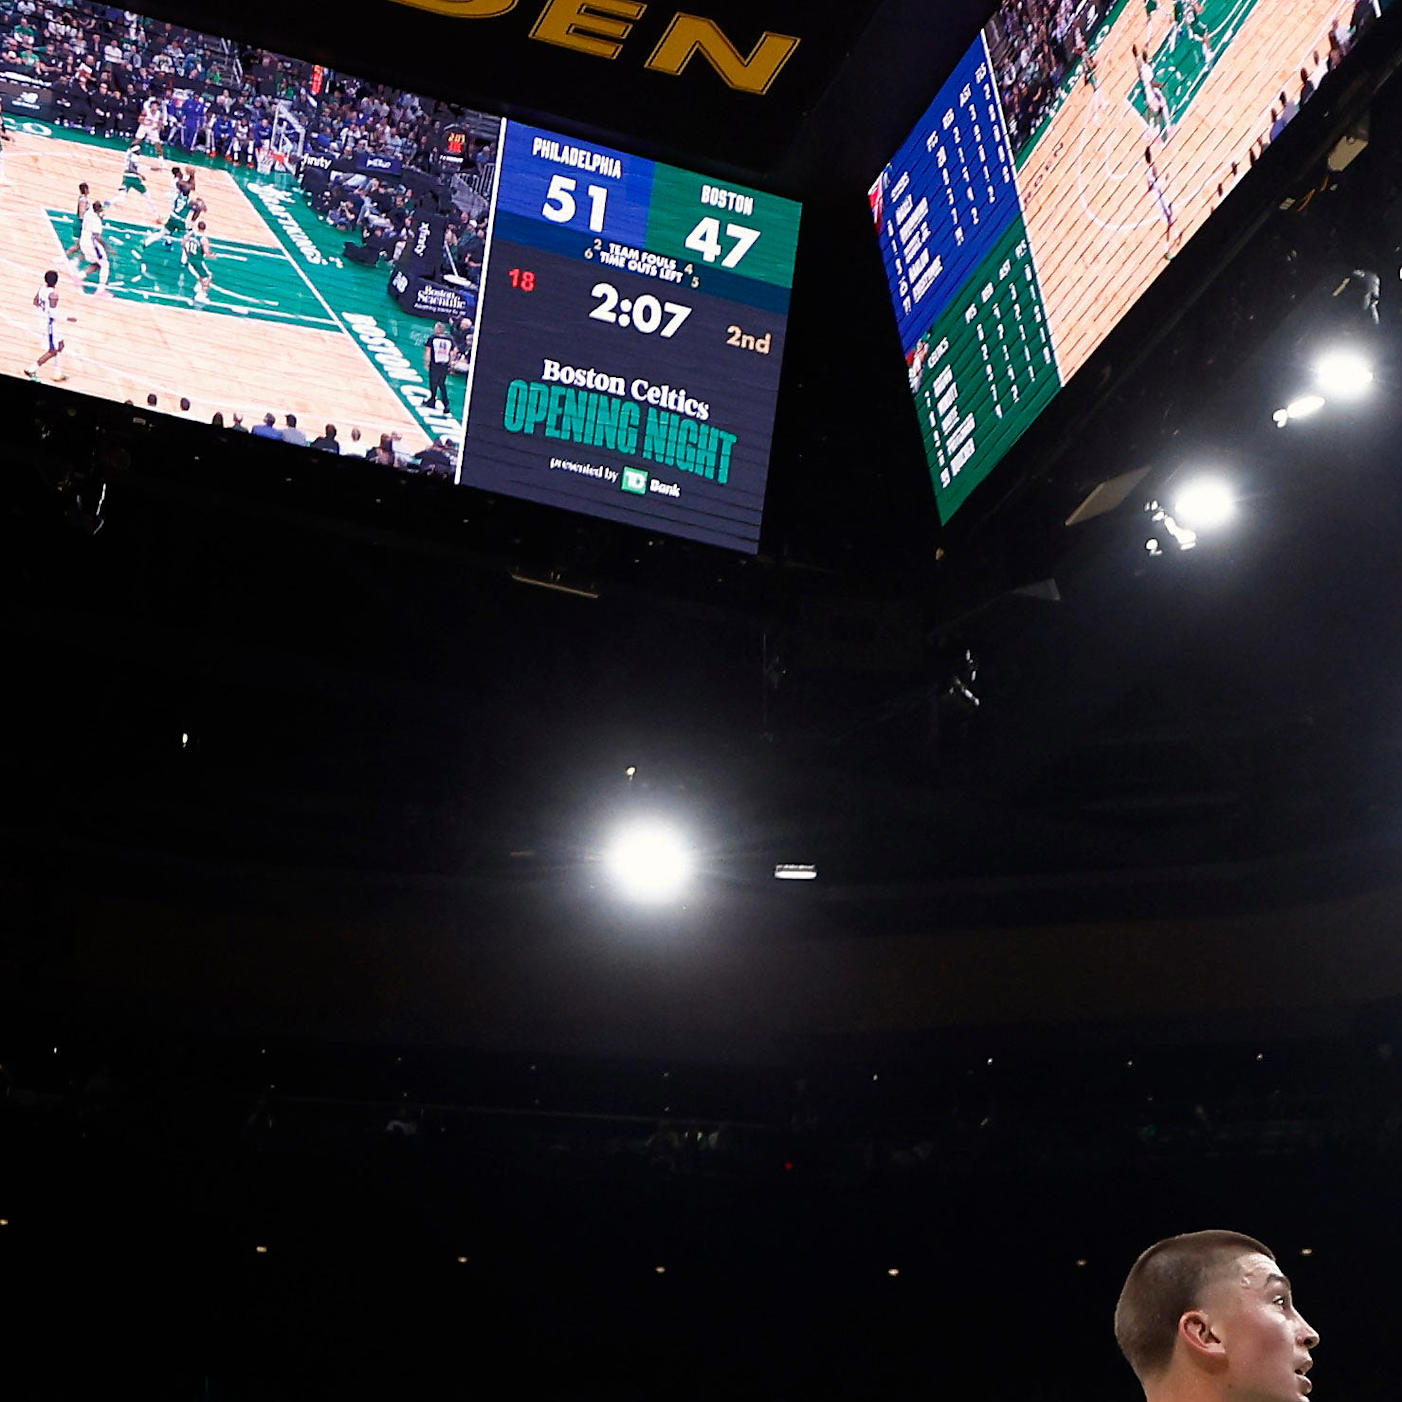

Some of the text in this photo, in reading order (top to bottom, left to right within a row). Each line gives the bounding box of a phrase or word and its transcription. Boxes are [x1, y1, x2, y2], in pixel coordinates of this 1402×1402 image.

[532, 137, 621, 179] PHILADELPHIA
[542, 174, 608, 233] 51
[701, 184, 754, 216] BOSTON
[593, 238, 694, 275] 2 TEAM FOULS 4
[684, 216, 761, 268] 47
[508, 267, 536, 292] 18
[584, 247, 700, 288] 6 TIME OUTS LEFT 5
[589, 282, 693, 338] 2:07
[726, 325, 772, 355] 2nd
[542, 358, 710, 420] Boston Celtics
[504, 379, 640, 455] OPENING
[642, 407, 738, 484] NIGHT
[550, 456, 603, 481] presented
[604, 466, 618, 484] by
[649, 479, 681, 498] Bank
